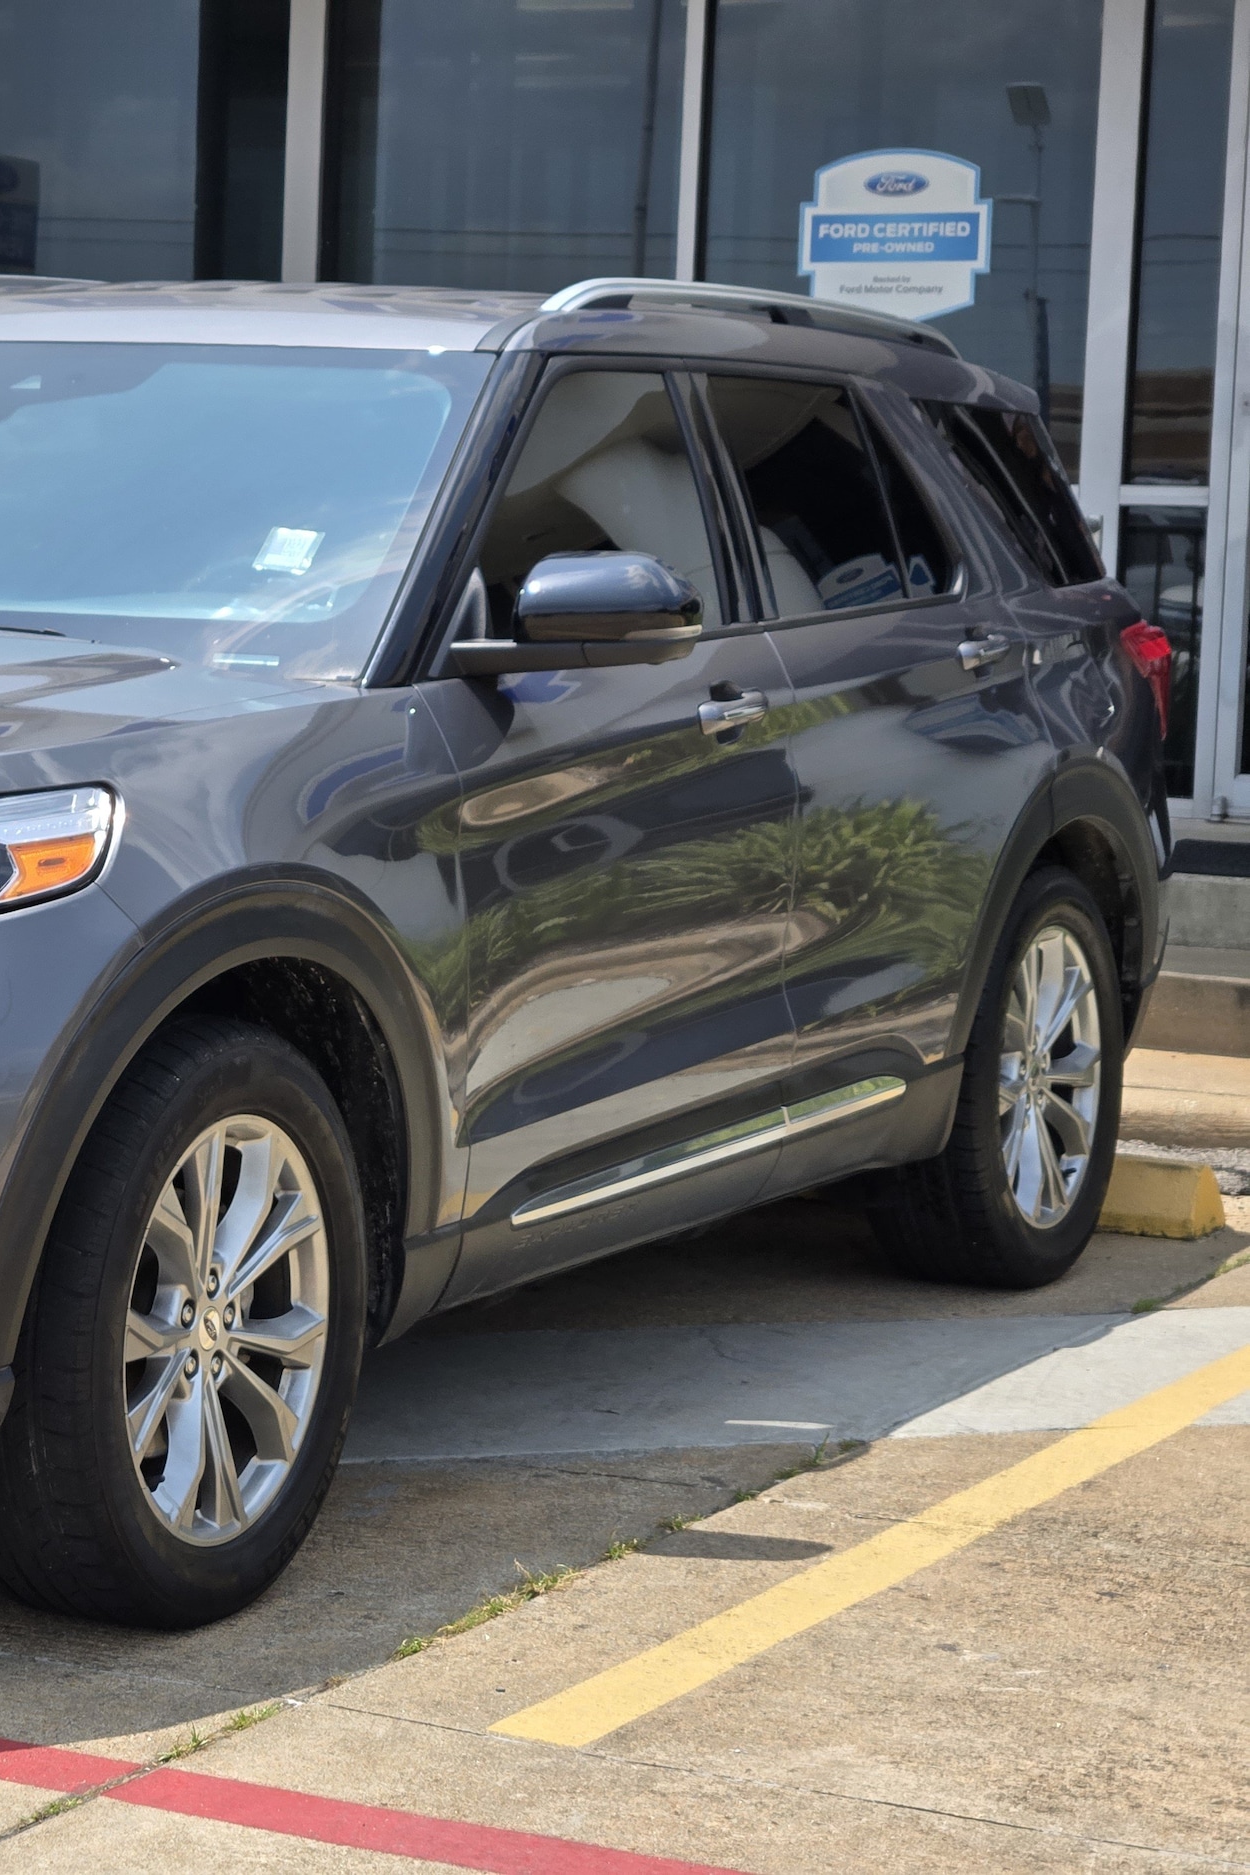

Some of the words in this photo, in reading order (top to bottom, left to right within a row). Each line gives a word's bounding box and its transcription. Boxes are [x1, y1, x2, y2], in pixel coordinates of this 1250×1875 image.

[876, 174, 917, 192] Ford
[818, 223, 870, 239] FORD
[873, 221, 971, 238] CERTIFIED
[852, 242, 935, 254] PRE-OWNED
[839, 284, 862, 294] Ford
[864, 285, 893, 294] Motor
[895, 284, 943, 295] Company
